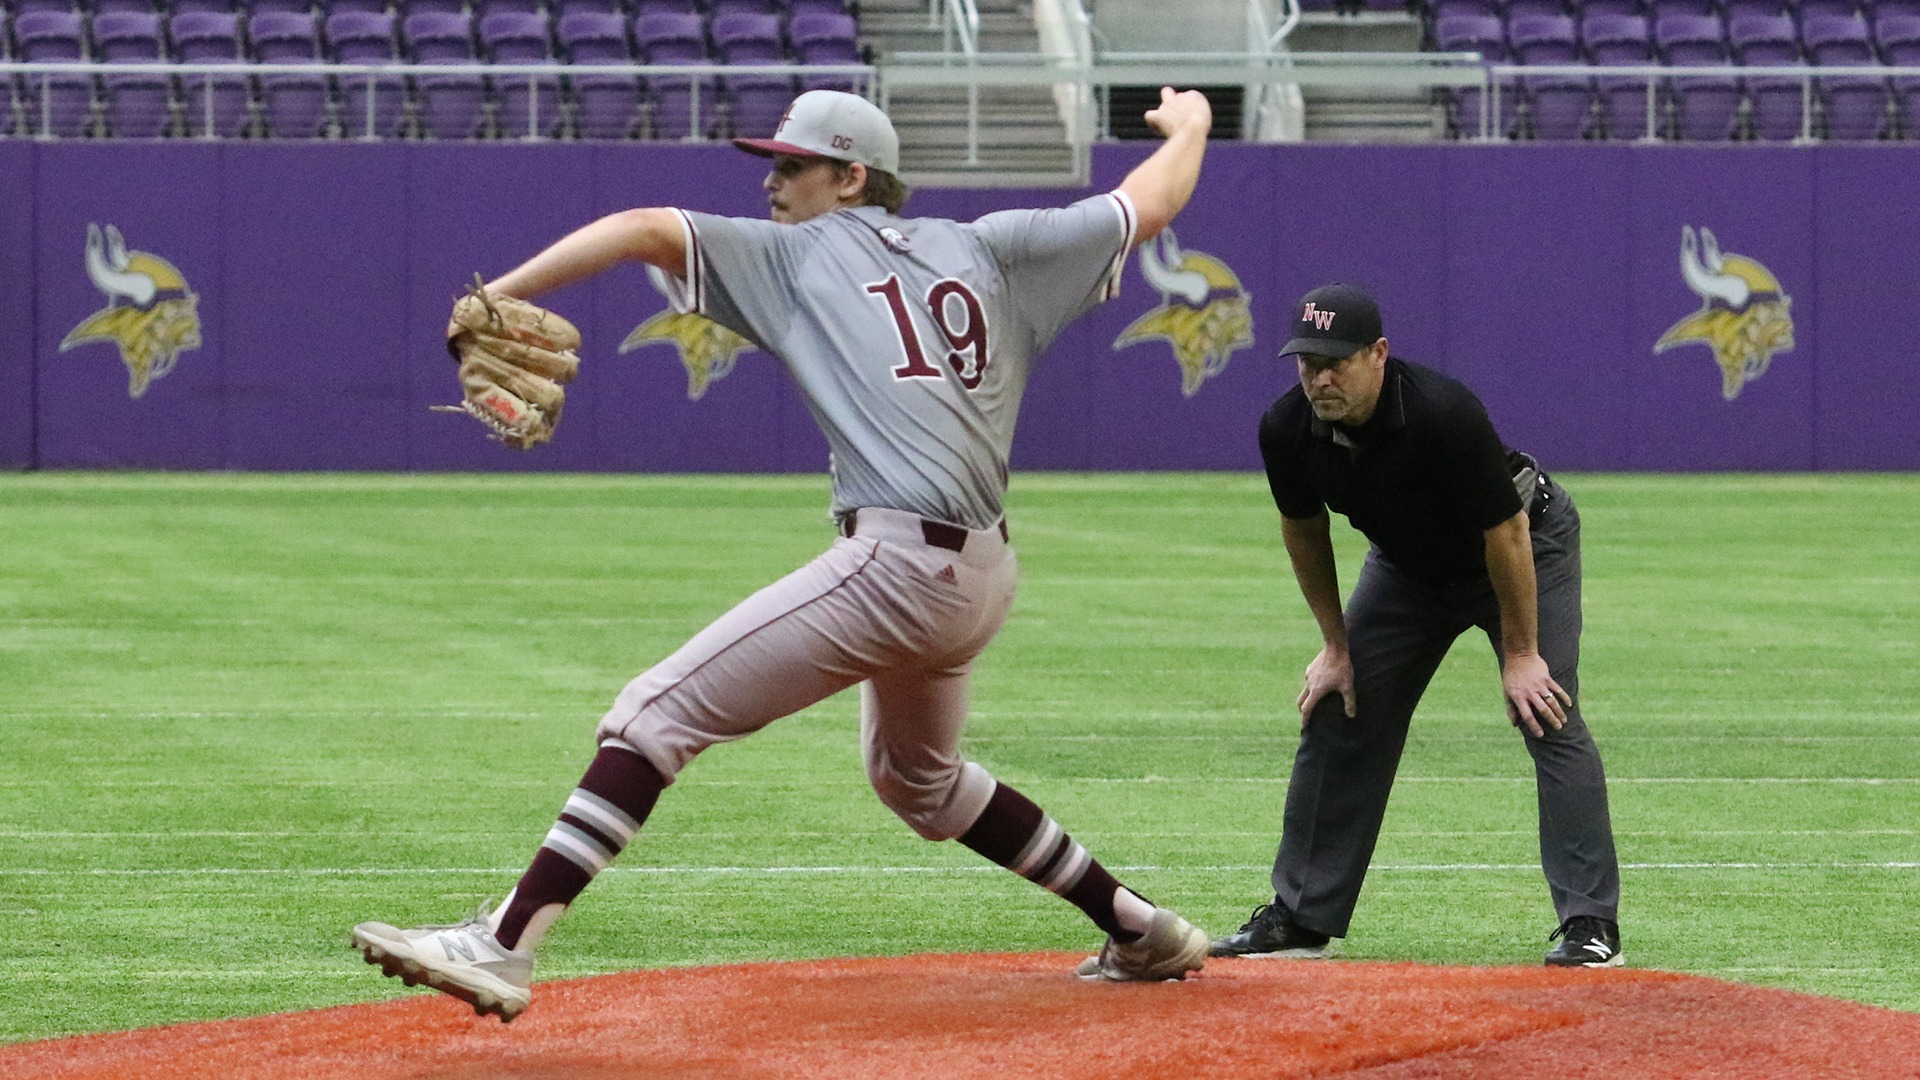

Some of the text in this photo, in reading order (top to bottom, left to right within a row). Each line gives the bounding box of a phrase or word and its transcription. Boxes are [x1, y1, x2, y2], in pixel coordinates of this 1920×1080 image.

[831, 134, 853, 151] DG
[1302, 302, 1336, 331] NW
[863, 272, 990, 392] 19
